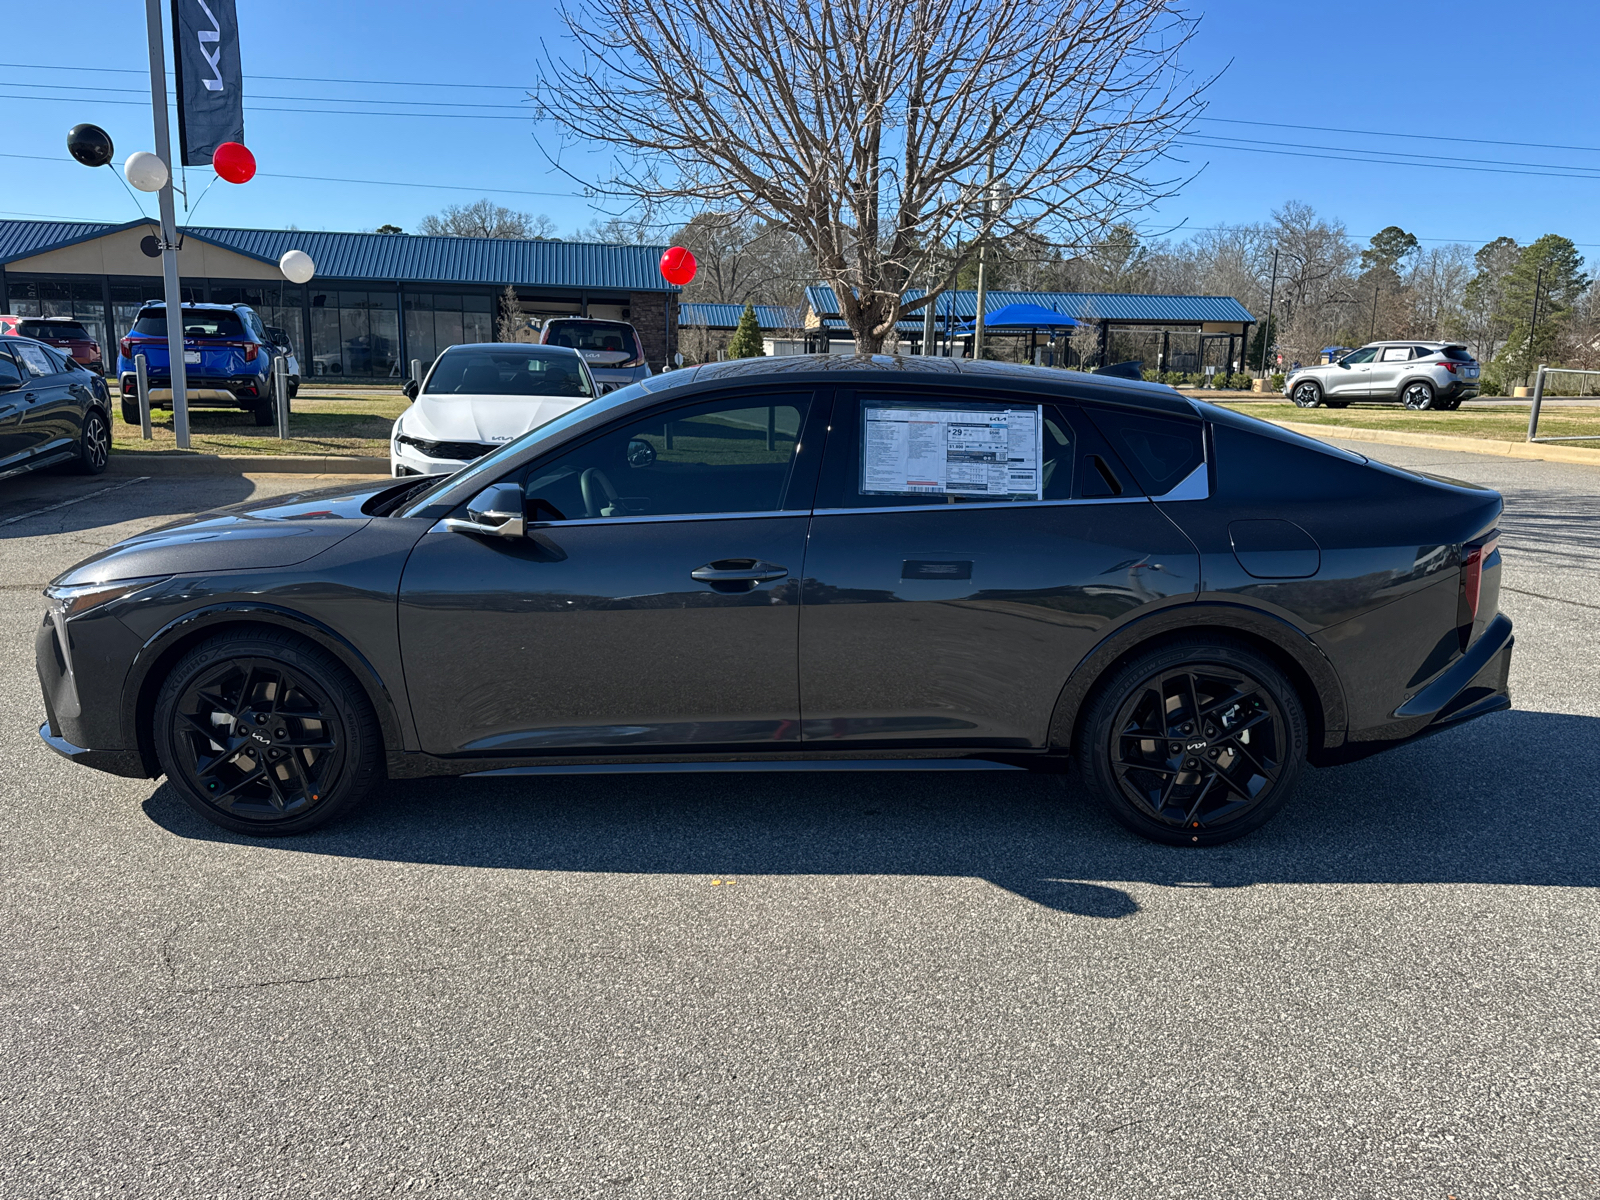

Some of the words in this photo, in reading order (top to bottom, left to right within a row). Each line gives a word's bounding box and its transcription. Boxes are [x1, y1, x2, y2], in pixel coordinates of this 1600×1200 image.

[952, 428, 963, 436] 29
[169, 654, 209, 692] KUMHO
[1284, 697, 1302, 749] KUMHO
[252, 732, 271, 745] KIA
[1187, 742, 1207, 750] KIA
